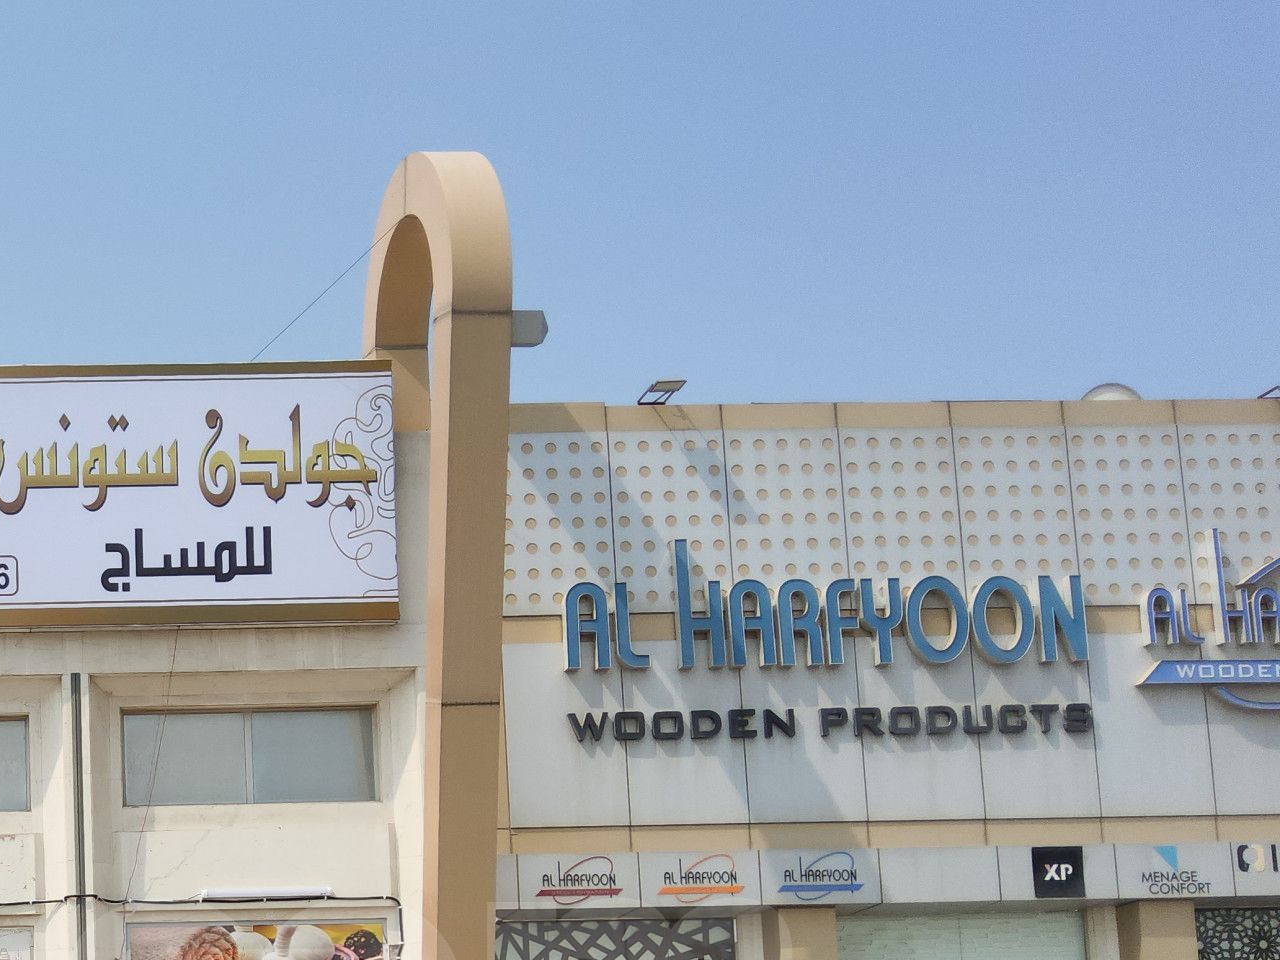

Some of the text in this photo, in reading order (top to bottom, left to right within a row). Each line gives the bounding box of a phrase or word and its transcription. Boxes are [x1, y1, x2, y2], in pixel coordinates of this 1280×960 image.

[100, 525, 273, 593] للمساج
[563, 539, 1089, 671] AL HARFYOON
[1142, 586, 1206, 648] AL
[567, 702, 1093, 743] WOODEN PRODUCTS
[542, 860, 616, 890] AL HARFYOON
[664, 858, 738, 887] AL HARFYOON
[784, 856, 857, 885] AL HARFYOON
[1043, 863, 1074, 881] XP
[1141, 871, 1199, 883] MENAGE
[1149, 882, 1212, 895] CONFORT
